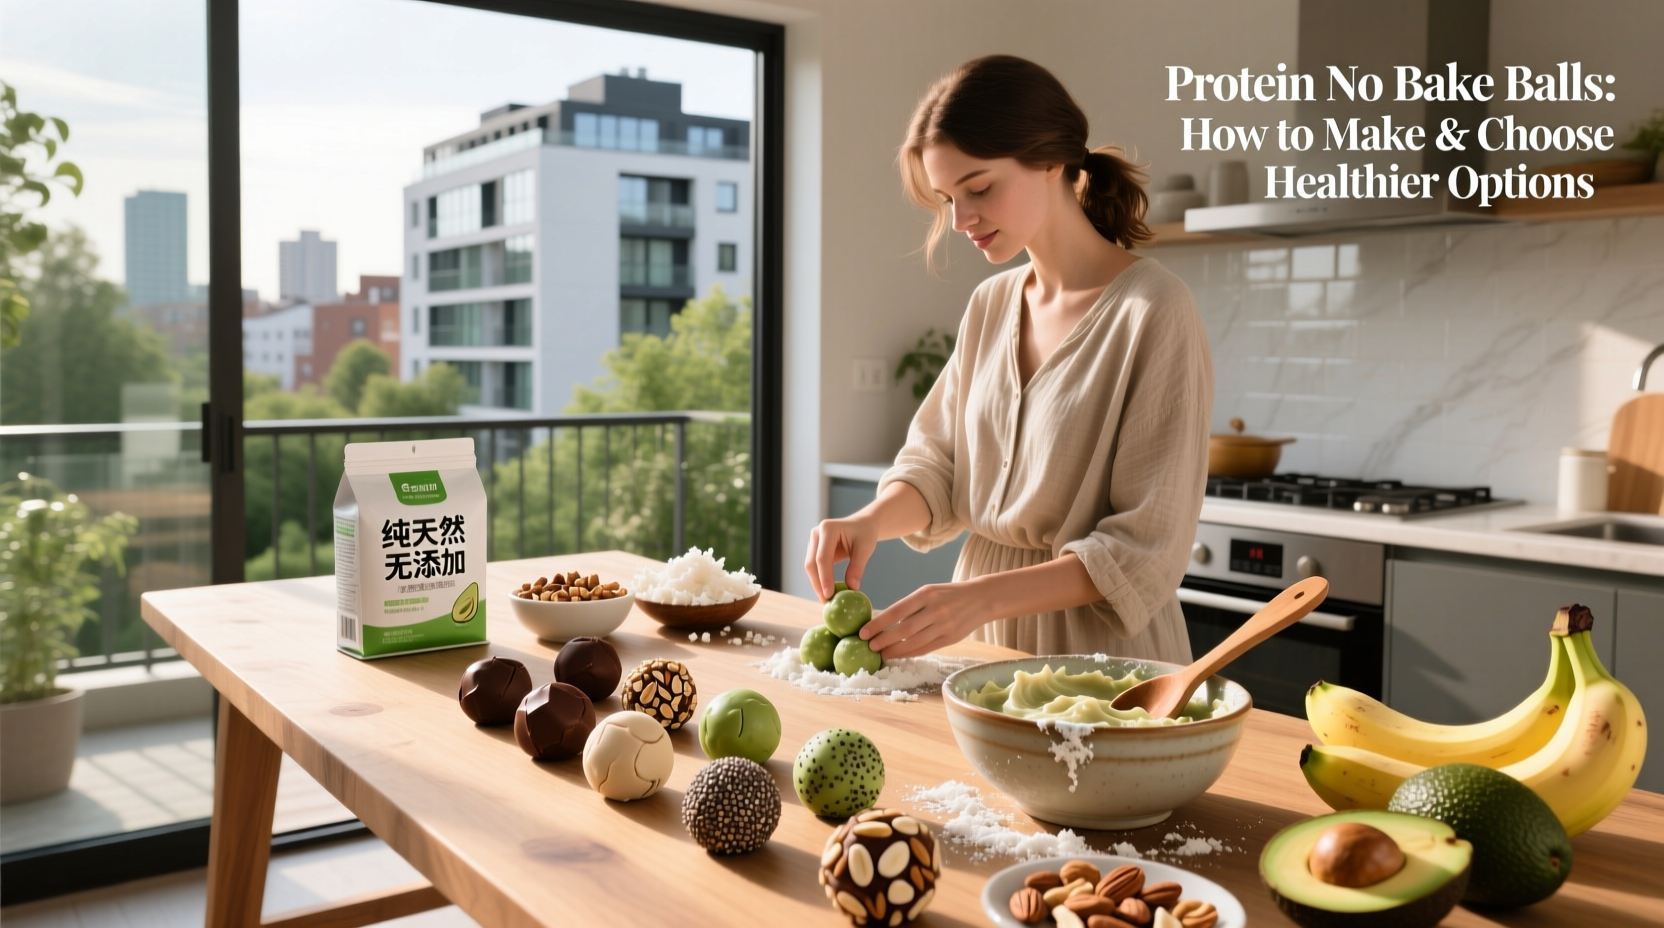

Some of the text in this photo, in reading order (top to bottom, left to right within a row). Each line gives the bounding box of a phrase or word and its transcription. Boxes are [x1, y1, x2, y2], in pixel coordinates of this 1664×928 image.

[381, 514, 466, 549] 纯天然
[384, 547, 466, 581] 无添加
